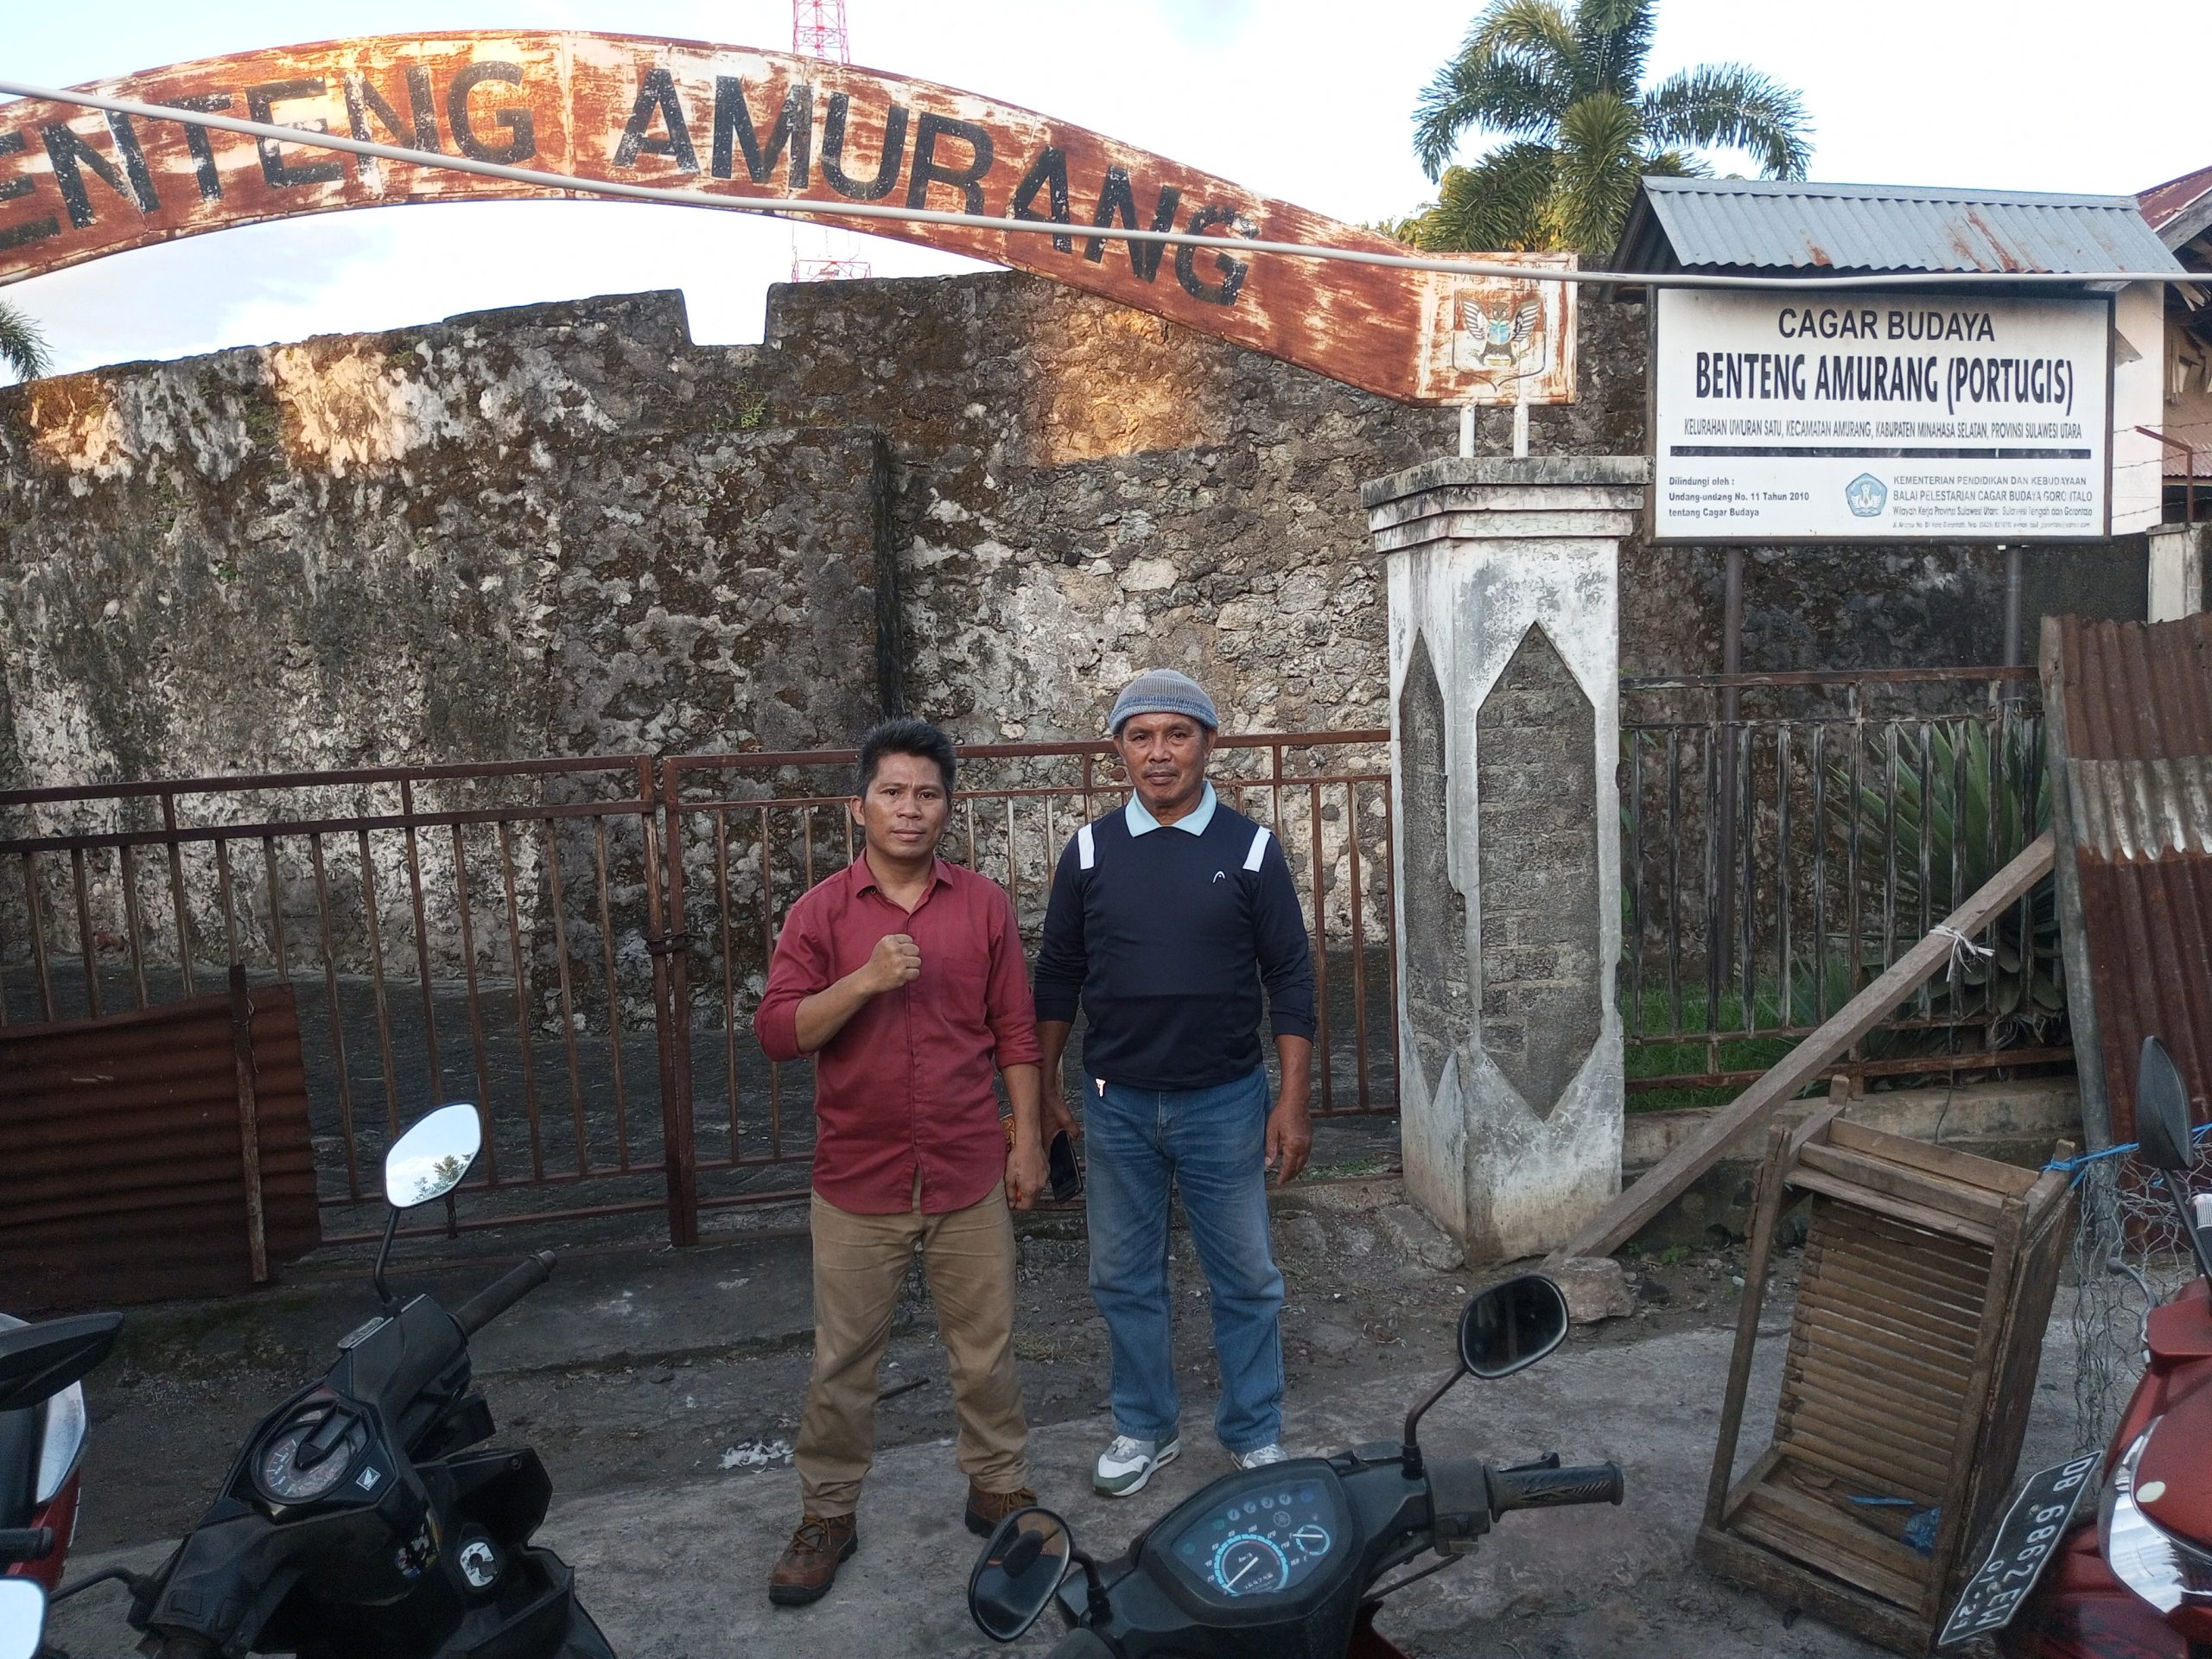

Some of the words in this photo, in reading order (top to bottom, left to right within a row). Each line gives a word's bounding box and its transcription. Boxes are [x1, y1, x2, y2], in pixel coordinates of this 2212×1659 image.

[612, 67, 1260, 307] AMURANG
[1779, 308, 1878, 340] CAGAR
[1888, 311, 1995, 341] BUDAYA
[1696, 352, 1806, 399] BENTENG
[1815, 355, 1938, 402] AMURANG
[1947, 359, 2074, 416] (PORTUGIS)
[1684, 418, 1727, 435] KELURAHAN
[1729, 419, 1763, 436] UWURAN
[1764, 420, 1784, 439] SATU,
[1785, 421, 1831, 438] KECAMATAN
[1833, 421, 1874, 440] AMURANG,
[1875, 422, 1916, 438] KABUPATEN
[1917, 422, 1955, 438] MINAHASA
[1957, 423, 1989, 440] SELATAN,
[1991, 423, 2024, 439] PROVINSI
[2025, 423, 2059, 439] SULAWESI
[2060, 423, 2082, 439] UTARA
[1669, 476, 1710, 487] Dilindungi
[1712, 477, 1729, 486] oleh
[1893, 476, 1955, 485] KEMENTERIAN
[1957, 476, 2009, 485] PENDIDIKAN
[2011, 476, 2029, 485] DAN
[2031, 477, 2087, 486] KEBUDAYAAN
[1669, 493, 1732, 503] Undang-undang
[1734, 493, 1748, 501] No.
[1763, 493, 1787, 501] Tahun
[1789, 493, 1809, 501] 2010
[1893, 490, 1918, 501] BALAI
[1920, 491, 1976, 501] PELESTARIAN
[1978, 491, 2007, 501] CAGAR
[2009, 491, 2042, 501] BUDAYA
[2043, 491, 2093, 502] GOROTALO
[1669, 508, 1700, 518] tentang
[1702, 508, 1727, 518] Cagar
[1729, 508, 1759, 518] Budaya
[1892, 505, 1916, 517] Wilayah
[2052, 1459, 2092, 1492] DB
[1974, 1588, 2020, 1626] EW
